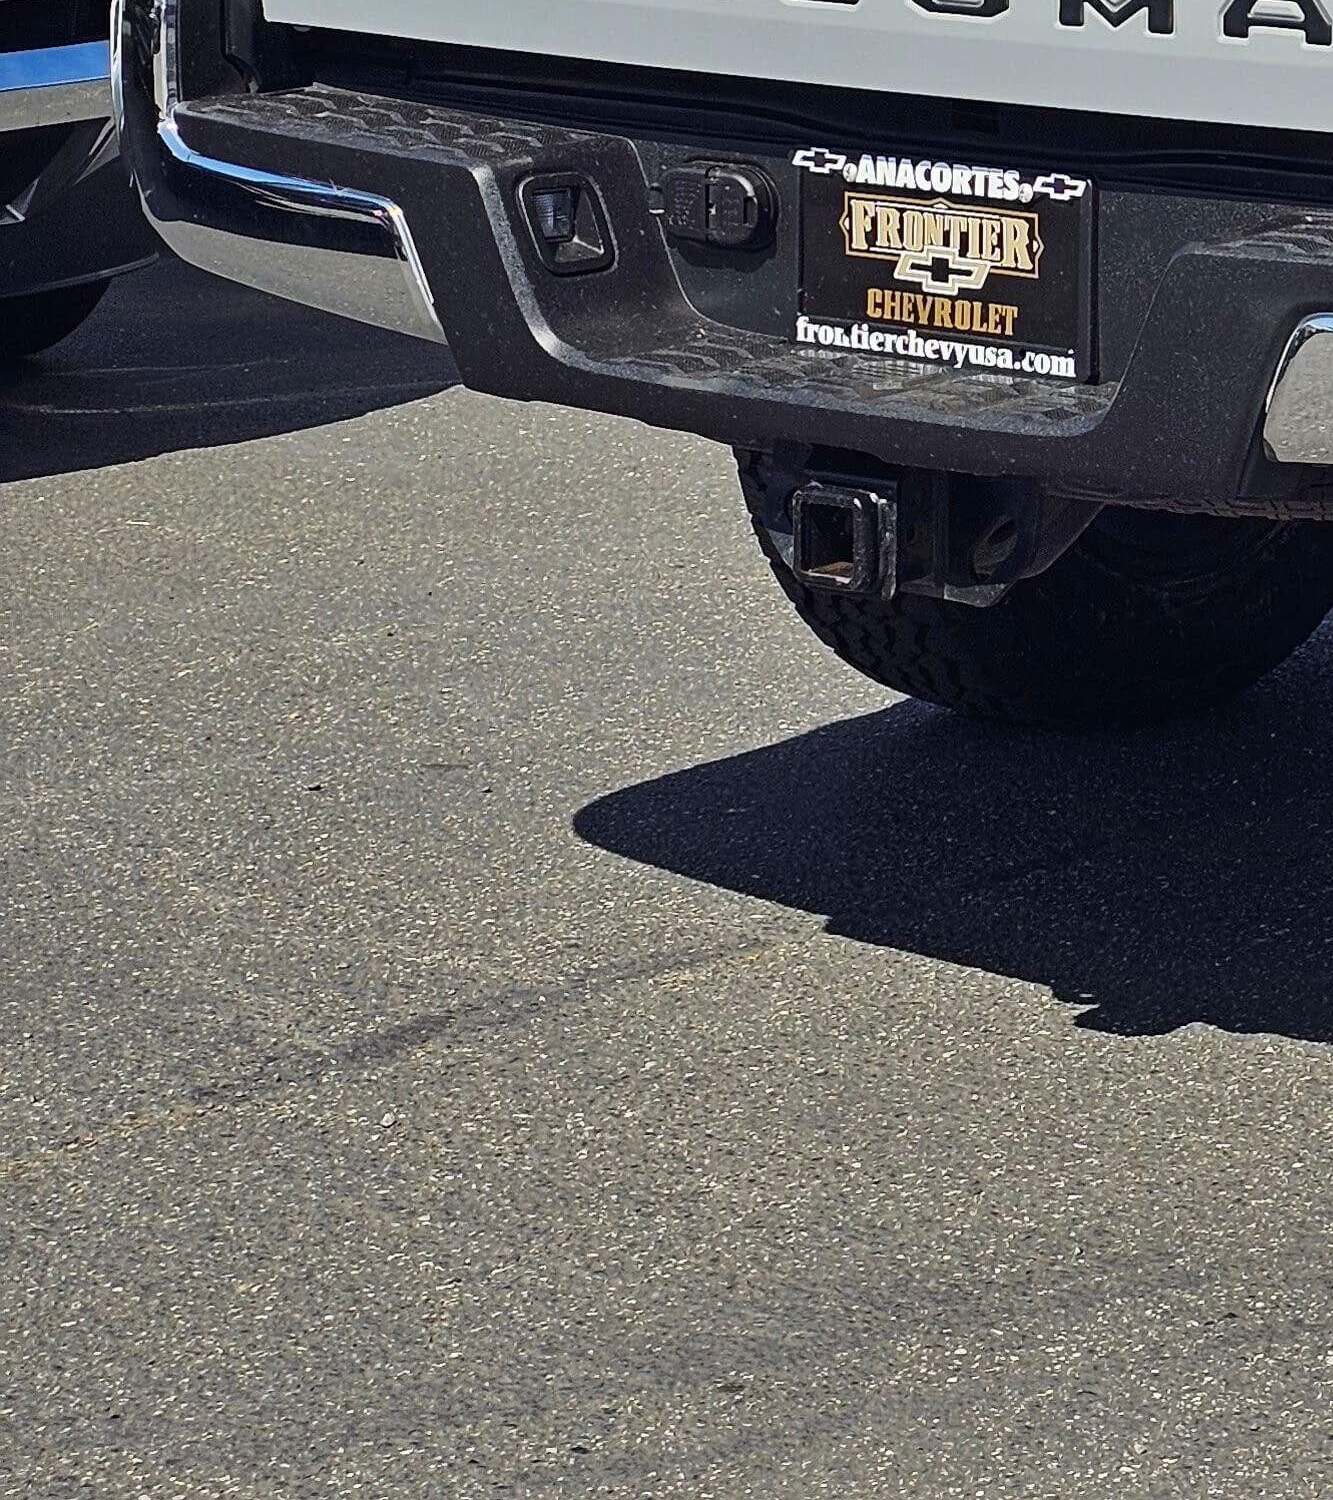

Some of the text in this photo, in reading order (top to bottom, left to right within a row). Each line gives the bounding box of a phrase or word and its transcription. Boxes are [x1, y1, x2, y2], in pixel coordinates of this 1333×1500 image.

[855, 154, 1021, 201] ANACORTES
[850, 199, 1034, 271] FRONTIER
[865, 288, 1019, 337] CHEVROLET
[795, 315, 1077, 378] frontierchevyusa.com
